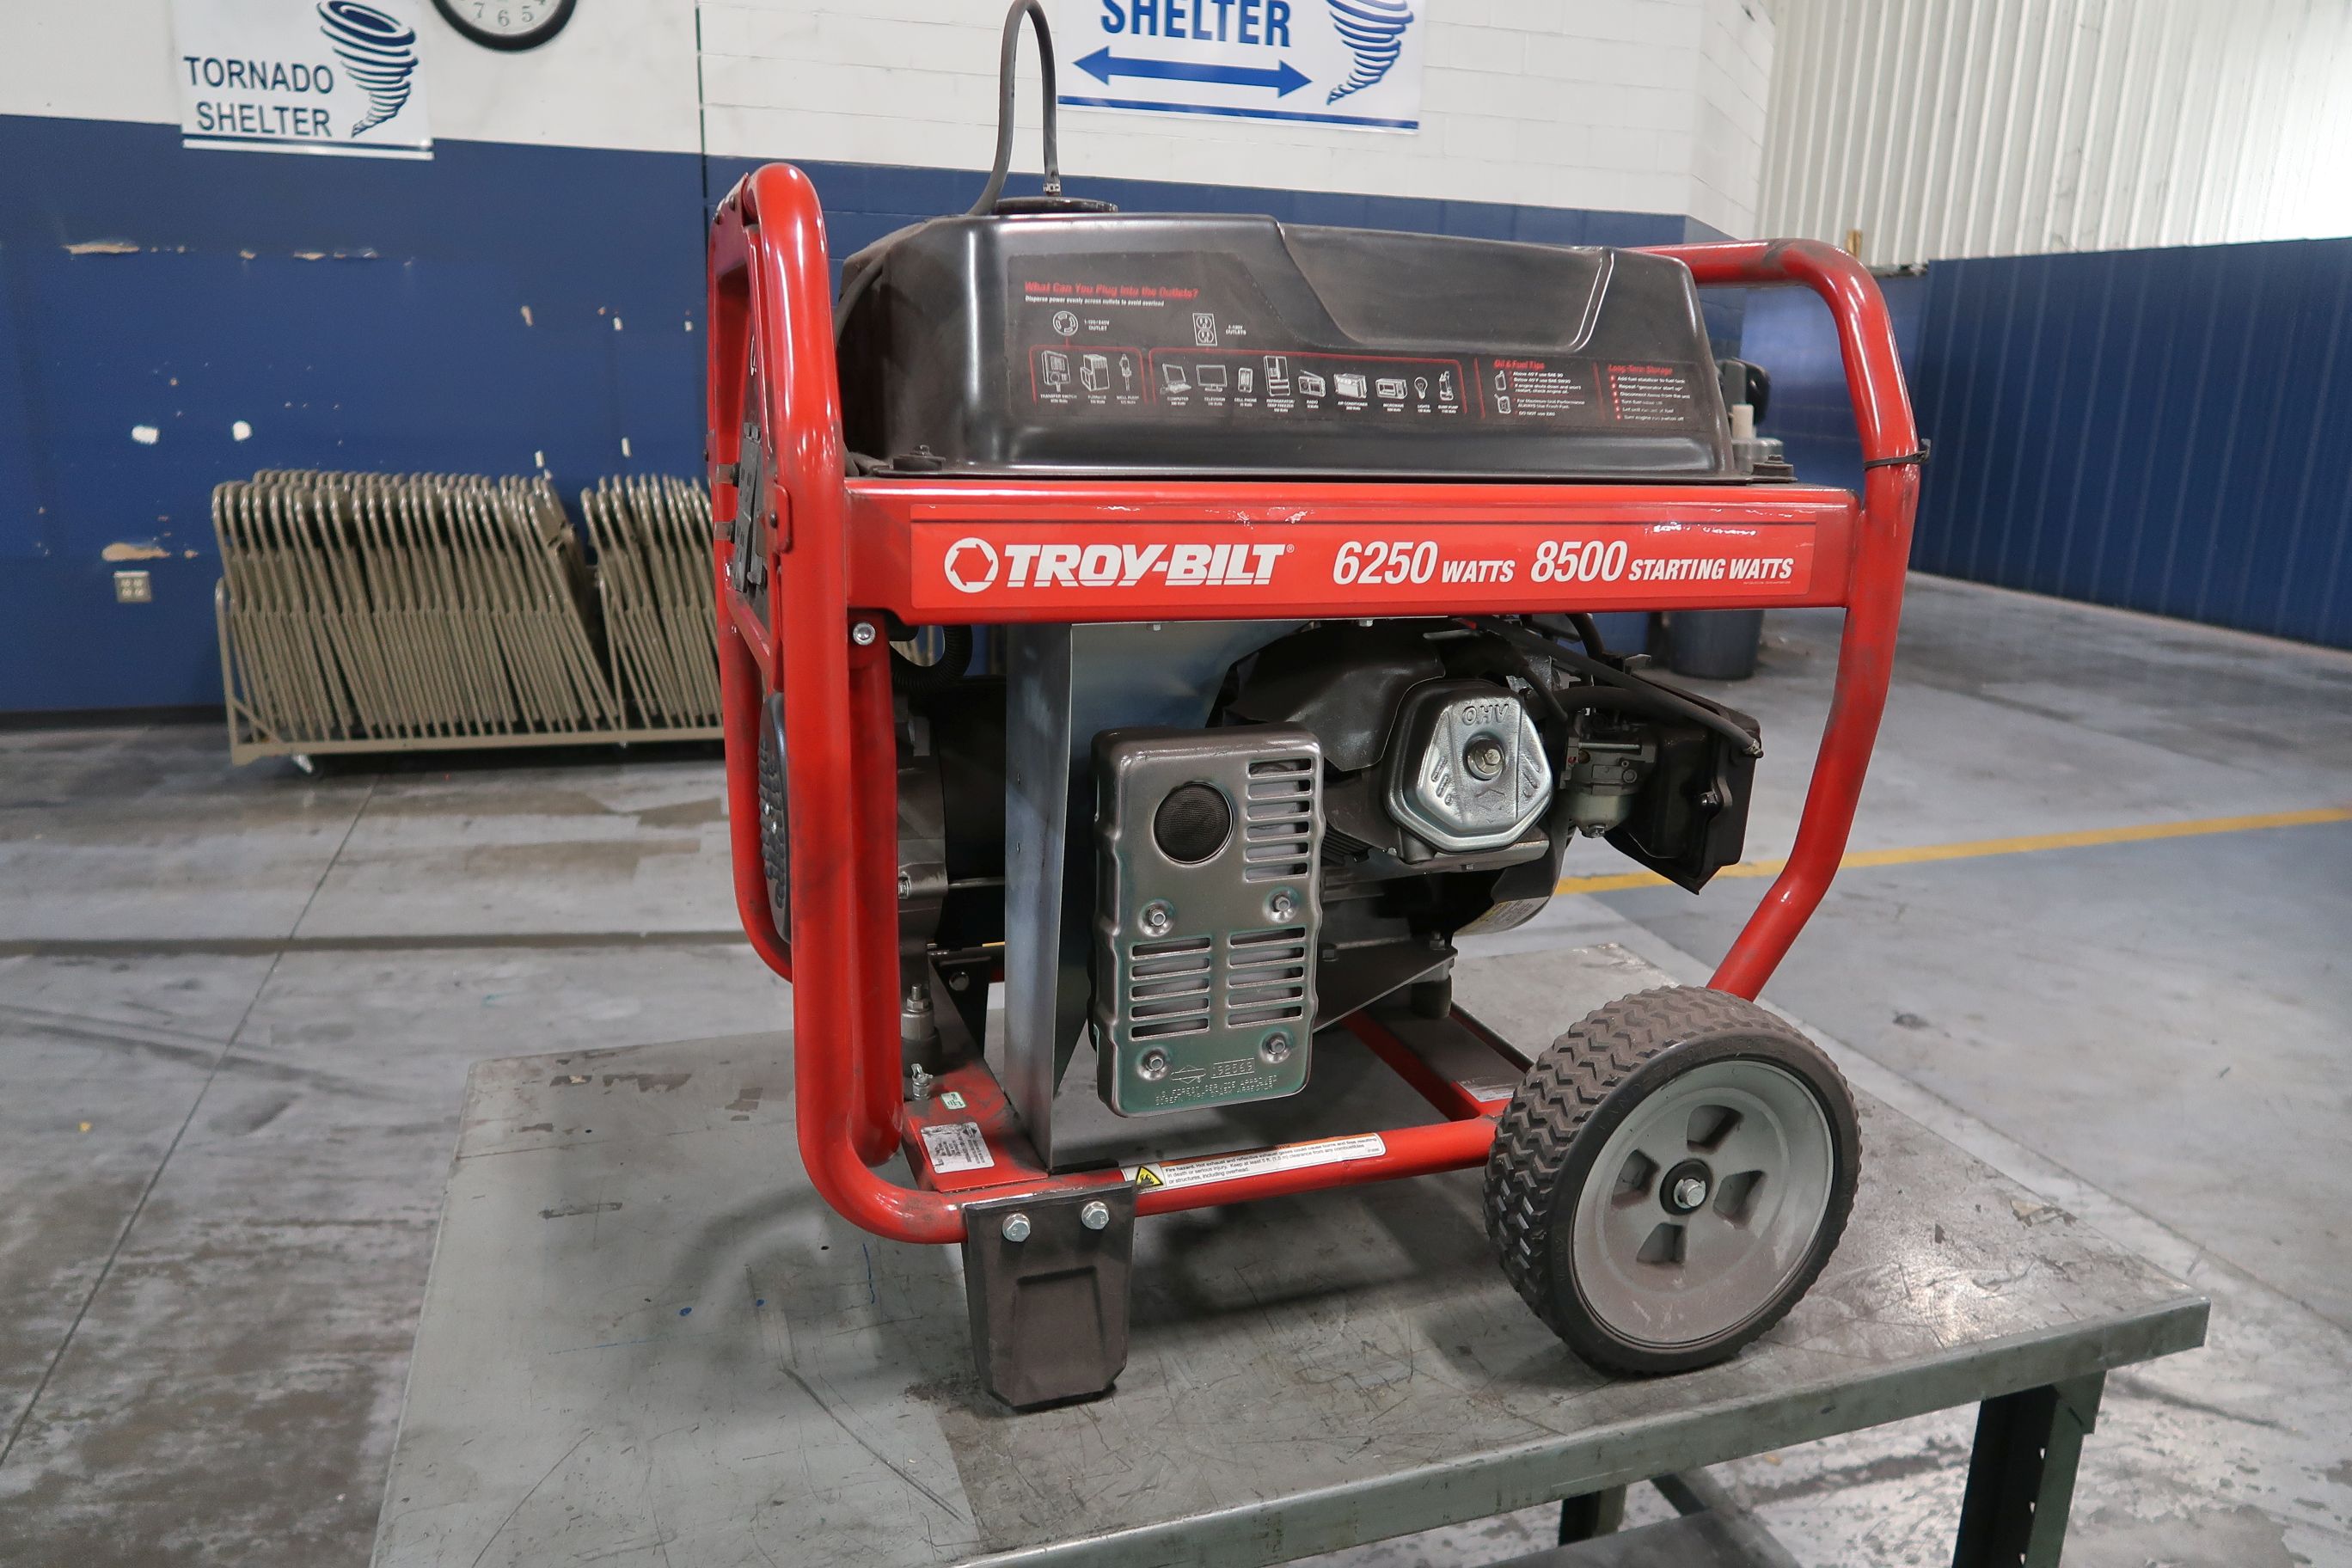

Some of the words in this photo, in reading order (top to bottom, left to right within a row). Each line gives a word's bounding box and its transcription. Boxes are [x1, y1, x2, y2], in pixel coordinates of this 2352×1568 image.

[474, 2, 484, 18] 7
[498, 9, 510, 27] 6
[522, 5, 534, 22] 5
[1101, 0, 1291, 47] SHELTER
[183, 56, 334, 94] TORNADO
[197, 101, 332, 138] SHELTER
[1025, 282, 1050, 293] What
[1053, 283, 1073, 294] Can
[1075, 283, 1093, 294] You
[1095, 284, 1118, 297] Plug
[1512, 361, 1528, 370] Fuel
[1004, 542, 1287, 588] TROY-BILT
[1332, 540, 1439, 585] 6250
[1442, 559, 1516, 584] WATTS
[1530, 540, 1629, 582] 8500
[1628, 557, 1725, 581] STARTING
[1728, 557, 1795, 580] WATTS
[1462, 703, 1510, 726] OHV
[1202, 1171, 1225, 1179] including
[1225, 1167, 1250, 1175] overhead.
